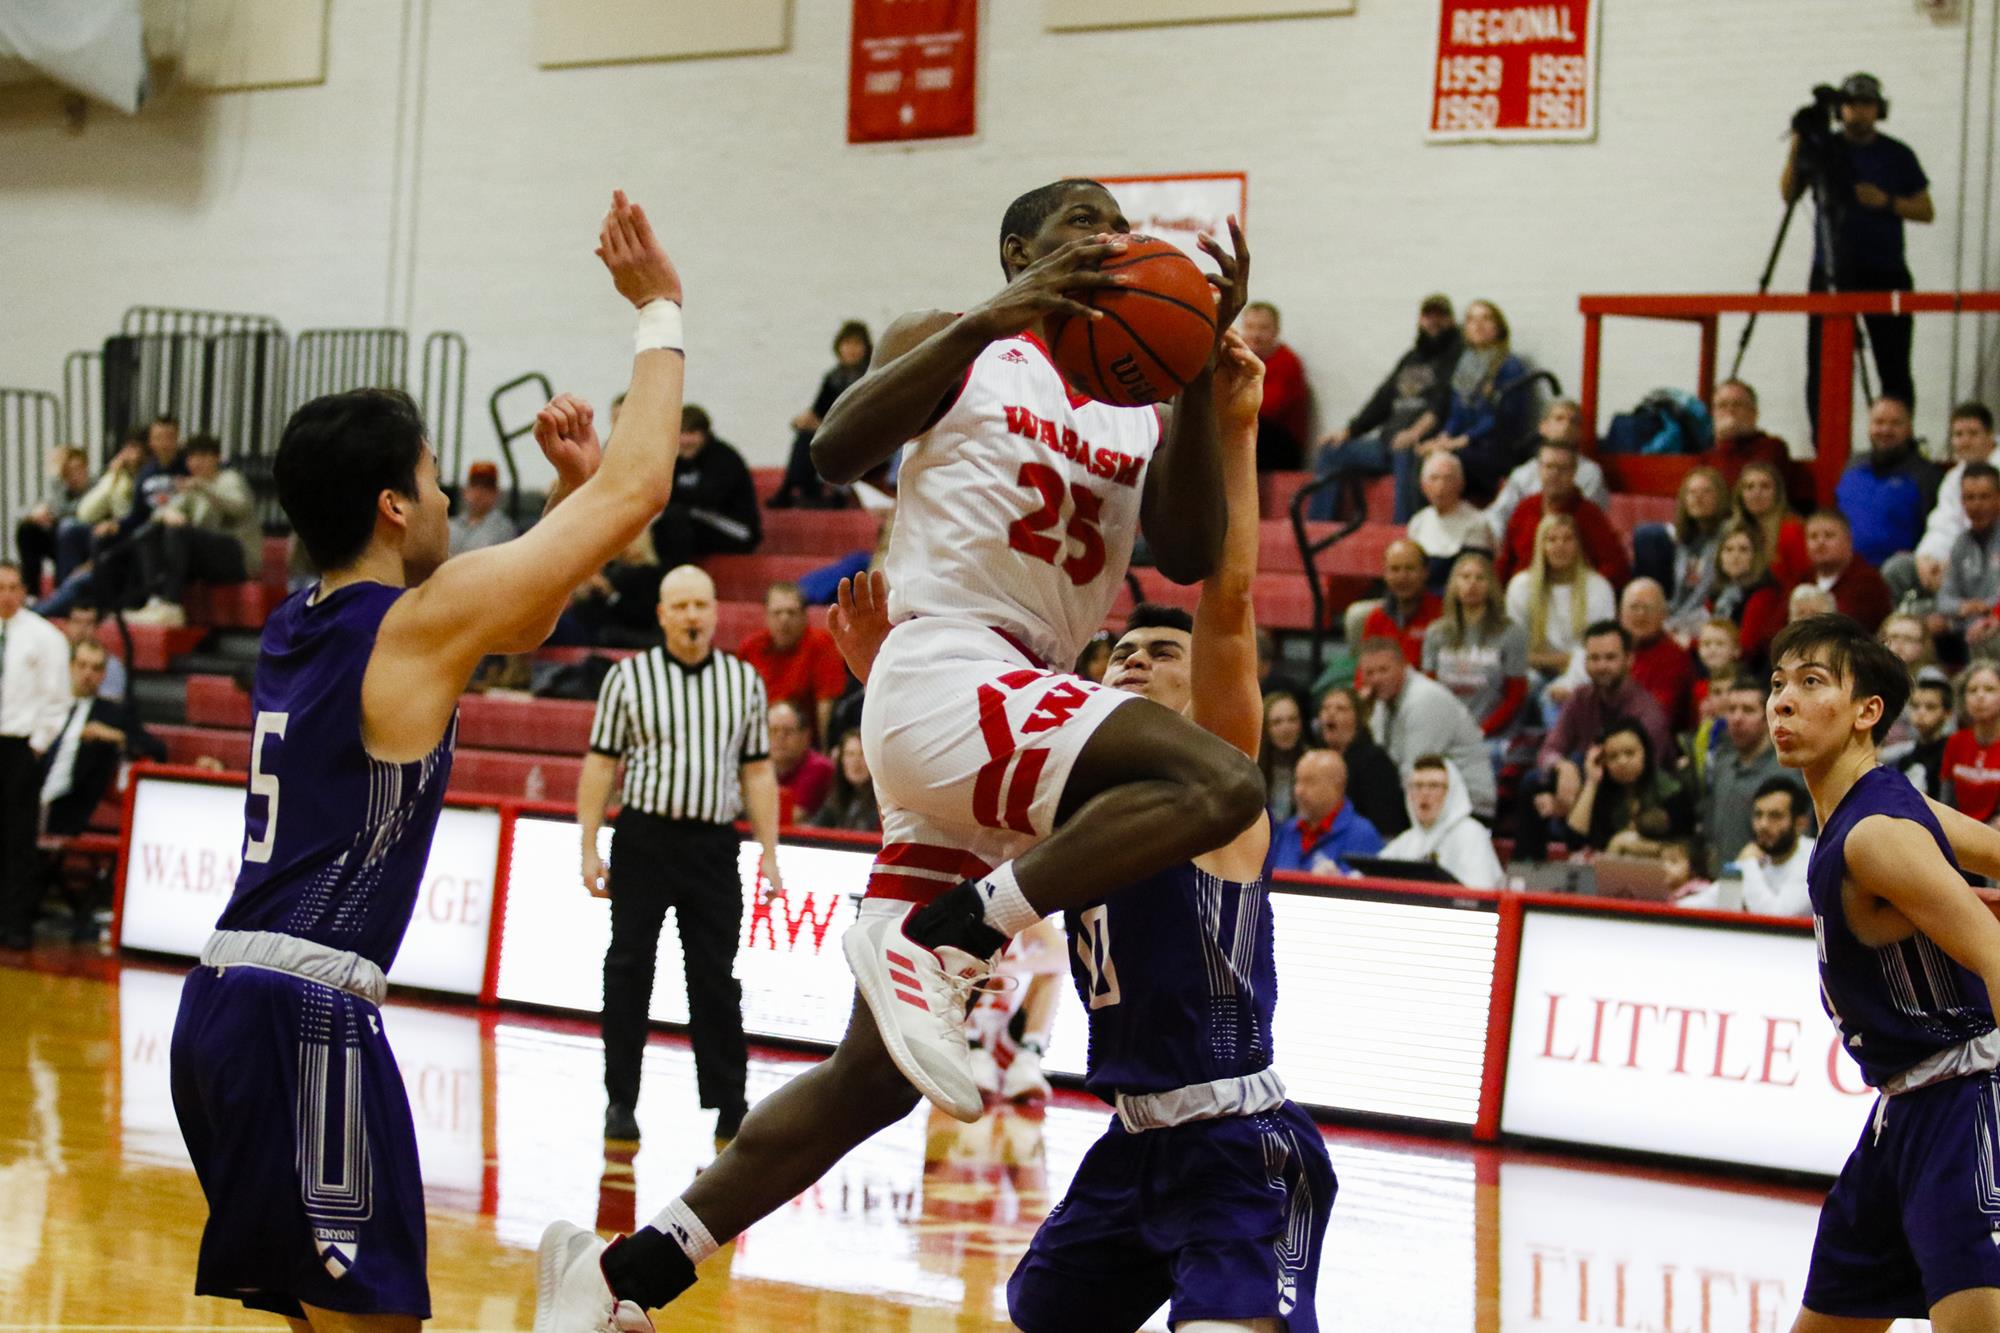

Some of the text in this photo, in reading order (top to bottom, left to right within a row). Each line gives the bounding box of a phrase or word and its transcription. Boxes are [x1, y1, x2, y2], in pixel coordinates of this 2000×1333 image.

[1452, 6, 1577, 45] REGIONAL
[1003, 405, 1145, 488] WABASH
[1009, 462, 1106, 586] 25
[244, 711, 290, 864] 5
[1536, 992, 1801, 1088] LITTLE
